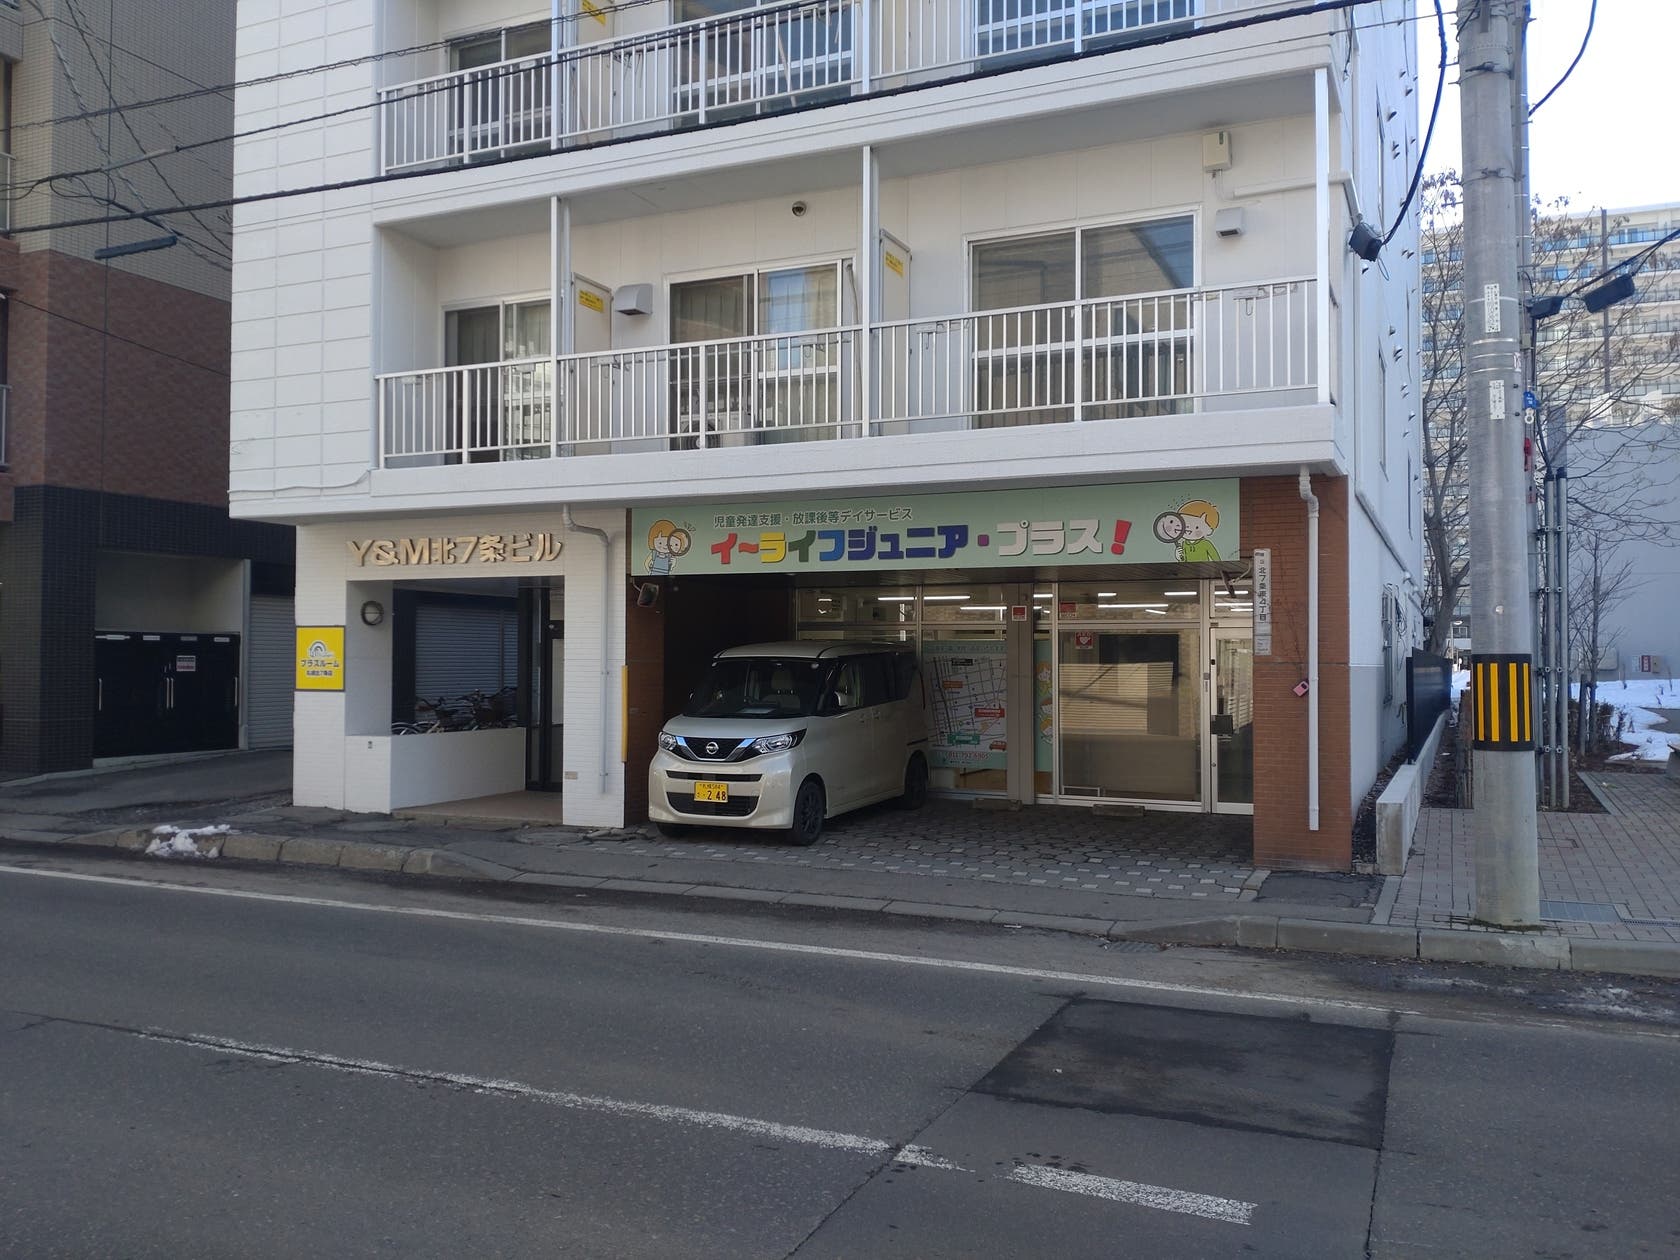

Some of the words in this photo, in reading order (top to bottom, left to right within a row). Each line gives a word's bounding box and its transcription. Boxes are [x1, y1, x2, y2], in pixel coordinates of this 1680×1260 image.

[714, 508, 913, 528] 児童発達支援・放課後等デイサービス
[345, 533, 563, 567] Y&M北7条ビル
[300, 659, 340, 668] プラスルーム
